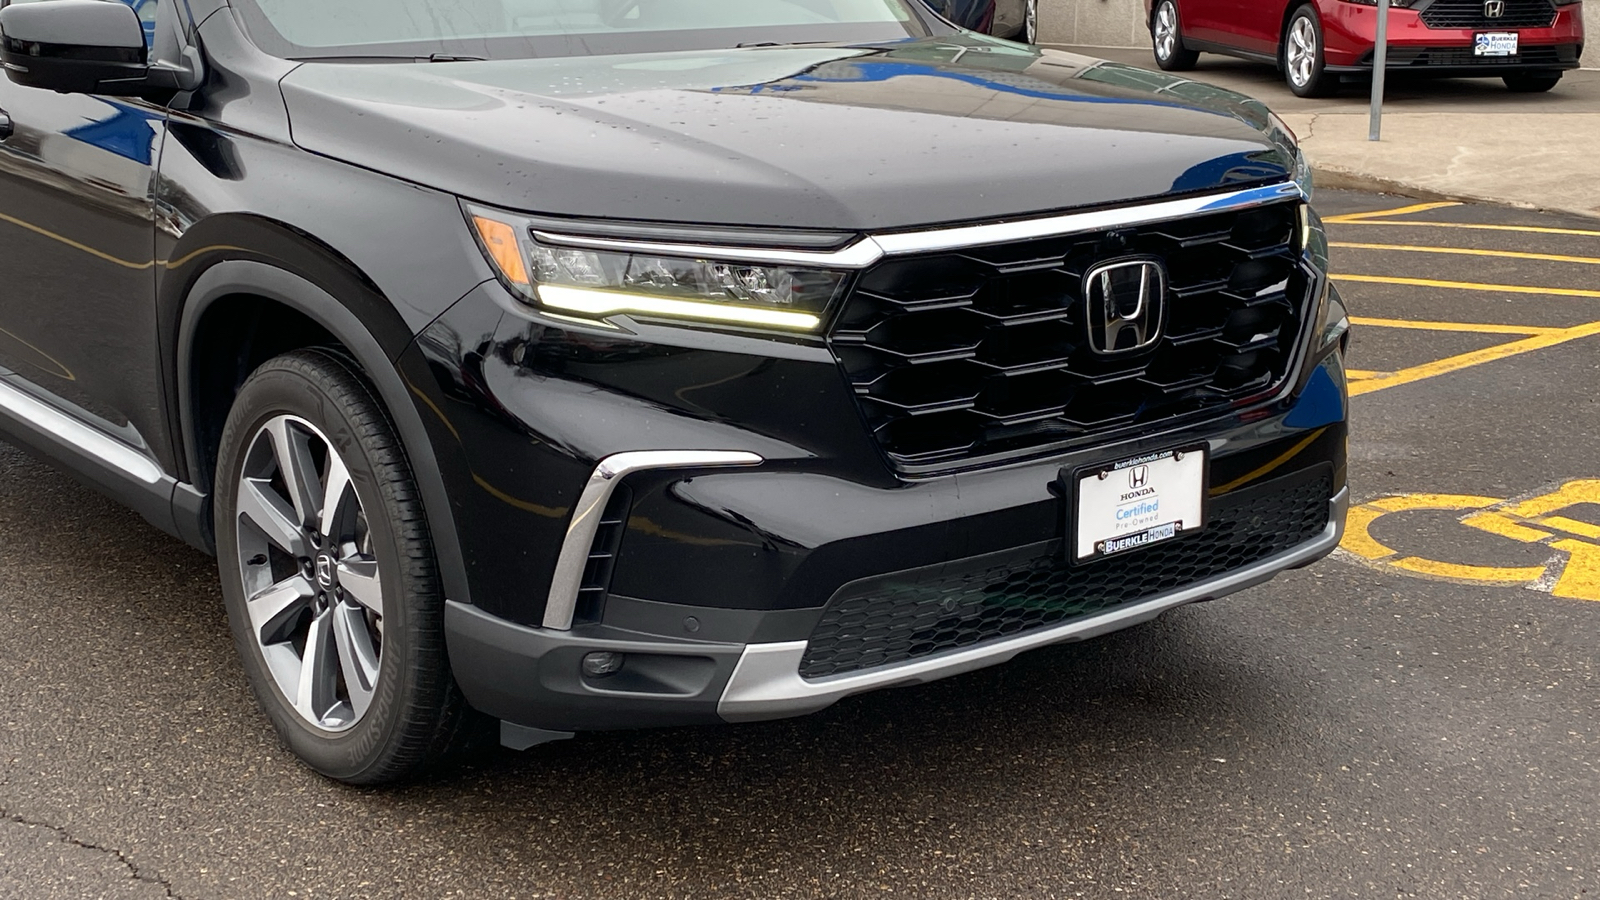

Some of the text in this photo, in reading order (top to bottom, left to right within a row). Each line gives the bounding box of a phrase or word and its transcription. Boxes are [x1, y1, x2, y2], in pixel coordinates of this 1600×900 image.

[1113, 450, 1174, 470] buerklehonda.com
[1120, 487, 1155, 502] HONDA
[1115, 499, 1159, 520] Certified
[1115, 513, 1159, 530] Pre-Owned
[1105, 527, 1174, 553] BUERKLE HONDA
[347, 634, 401, 767] BRIDGESTONE
